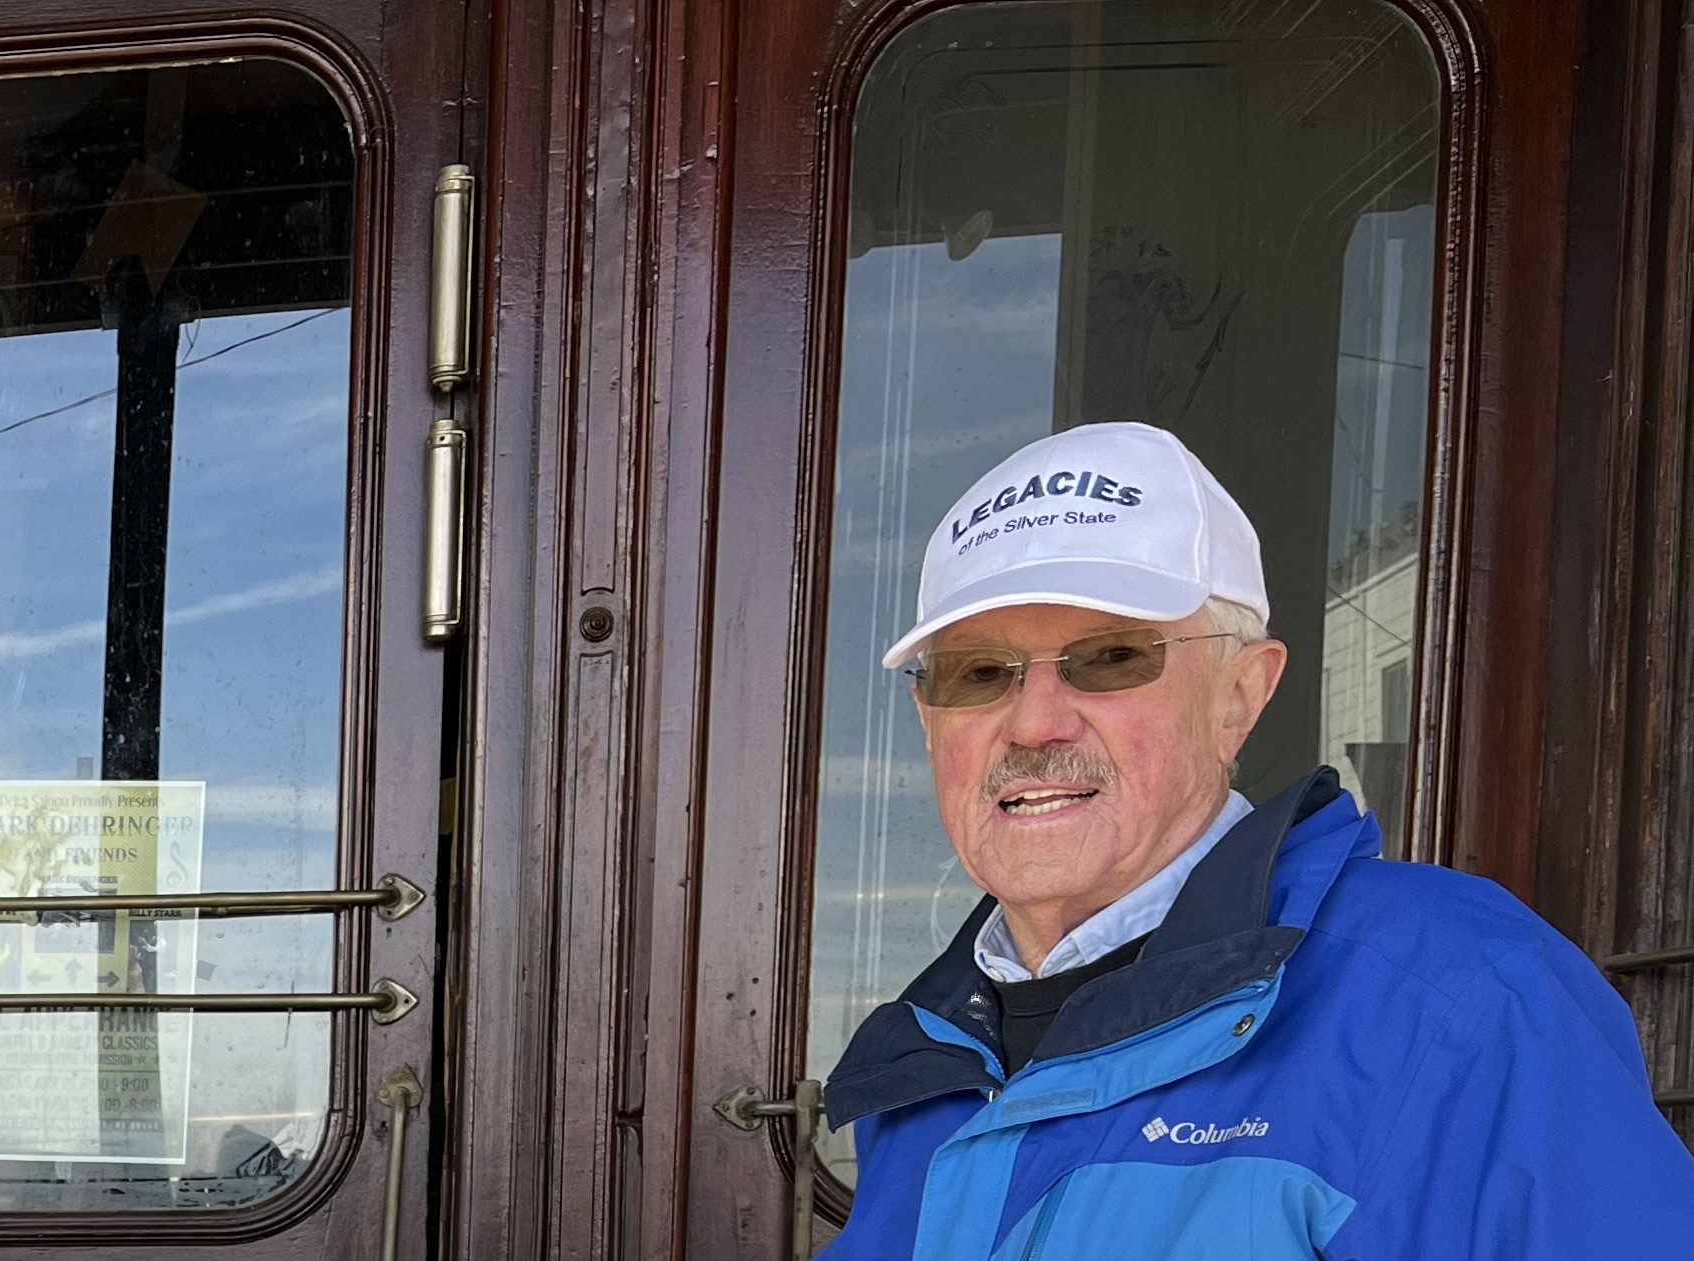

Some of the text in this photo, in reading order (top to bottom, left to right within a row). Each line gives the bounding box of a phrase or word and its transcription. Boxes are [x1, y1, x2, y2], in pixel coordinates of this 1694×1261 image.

[951, 470, 1143, 544] LEGACIES
[958, 511, 1117, 556] of the Silver State
[72, 795, 114, 808] Proudly
[51, 816, 193, 836] DEHRINGER
[103, 1036, 158, 1050] CLASSICS
[121, 1078, 149, 1092] 9:00
[1169, 1117, 1269, 1144] Columbia
